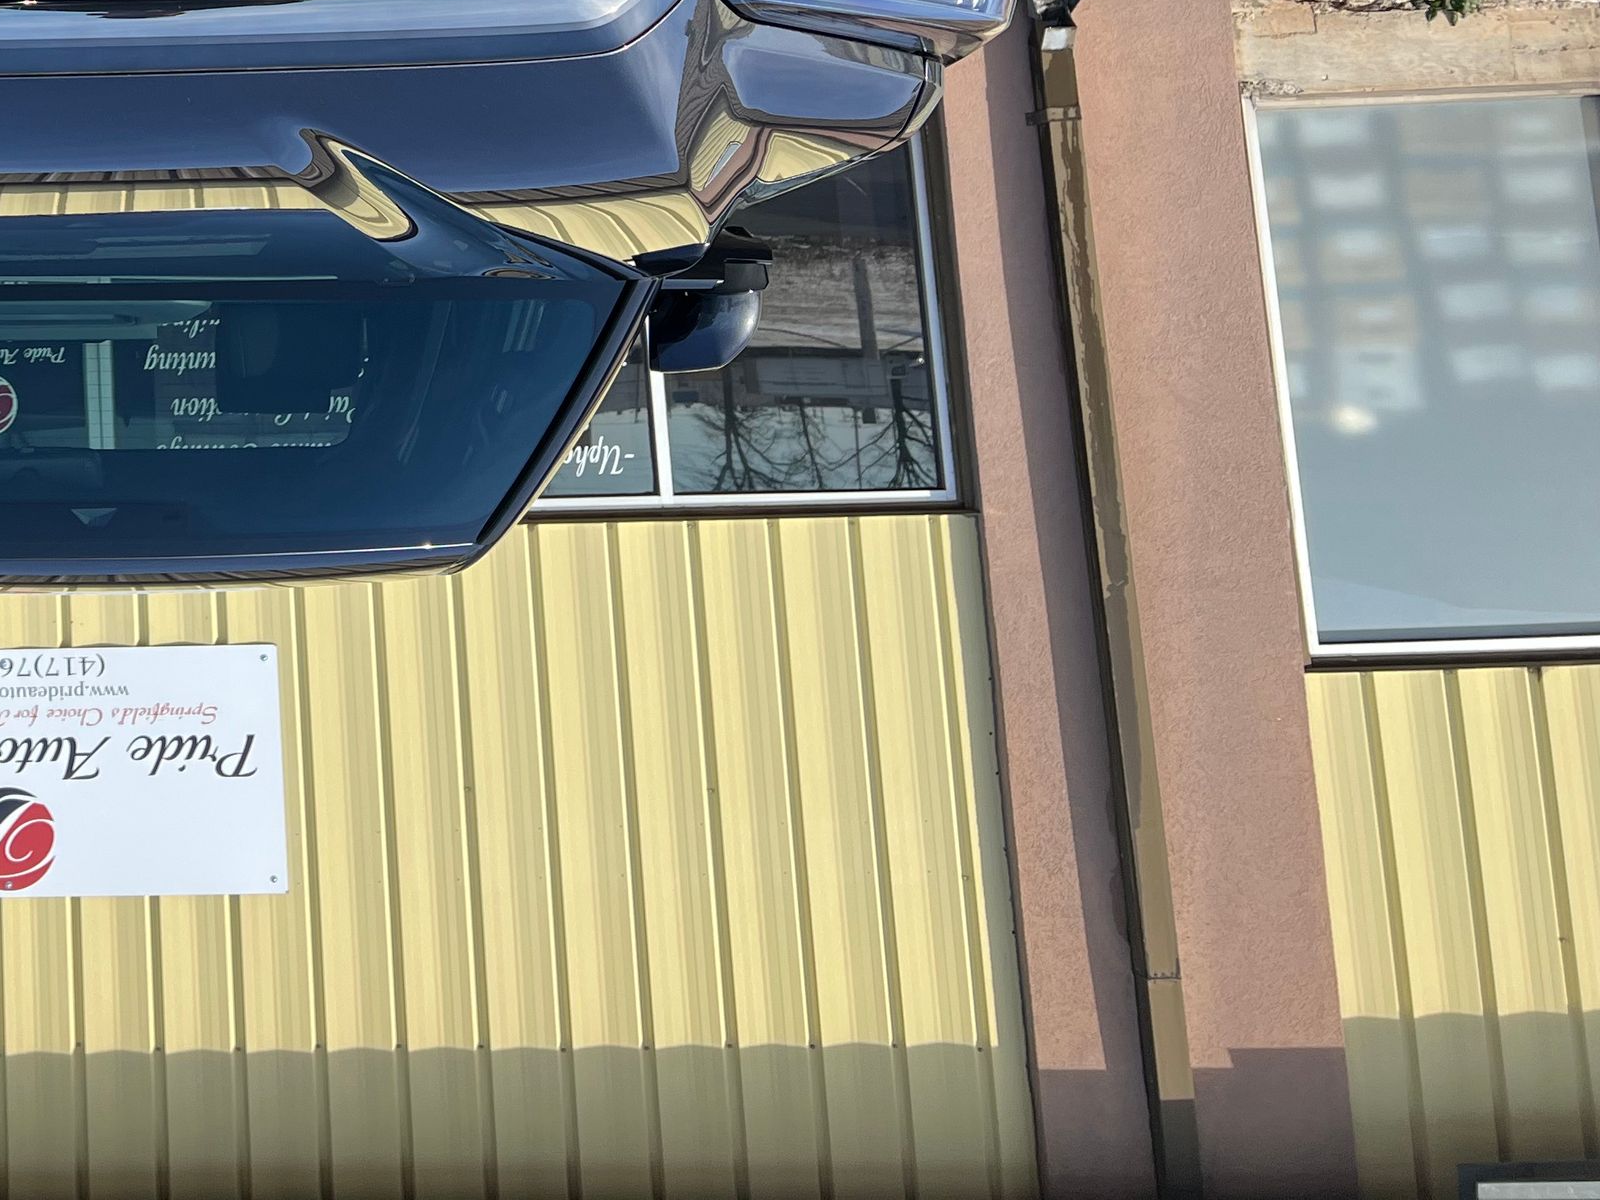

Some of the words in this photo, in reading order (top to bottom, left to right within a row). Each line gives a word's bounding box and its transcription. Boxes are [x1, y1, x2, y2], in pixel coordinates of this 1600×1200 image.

[23, 346, 66, 363] Pride
[14, 704, 38, 726] for
[46, 707, 102, 727] Choice
[111, 703, 218, 726] Springfield's
[126, 734, 257, 778] Pride
